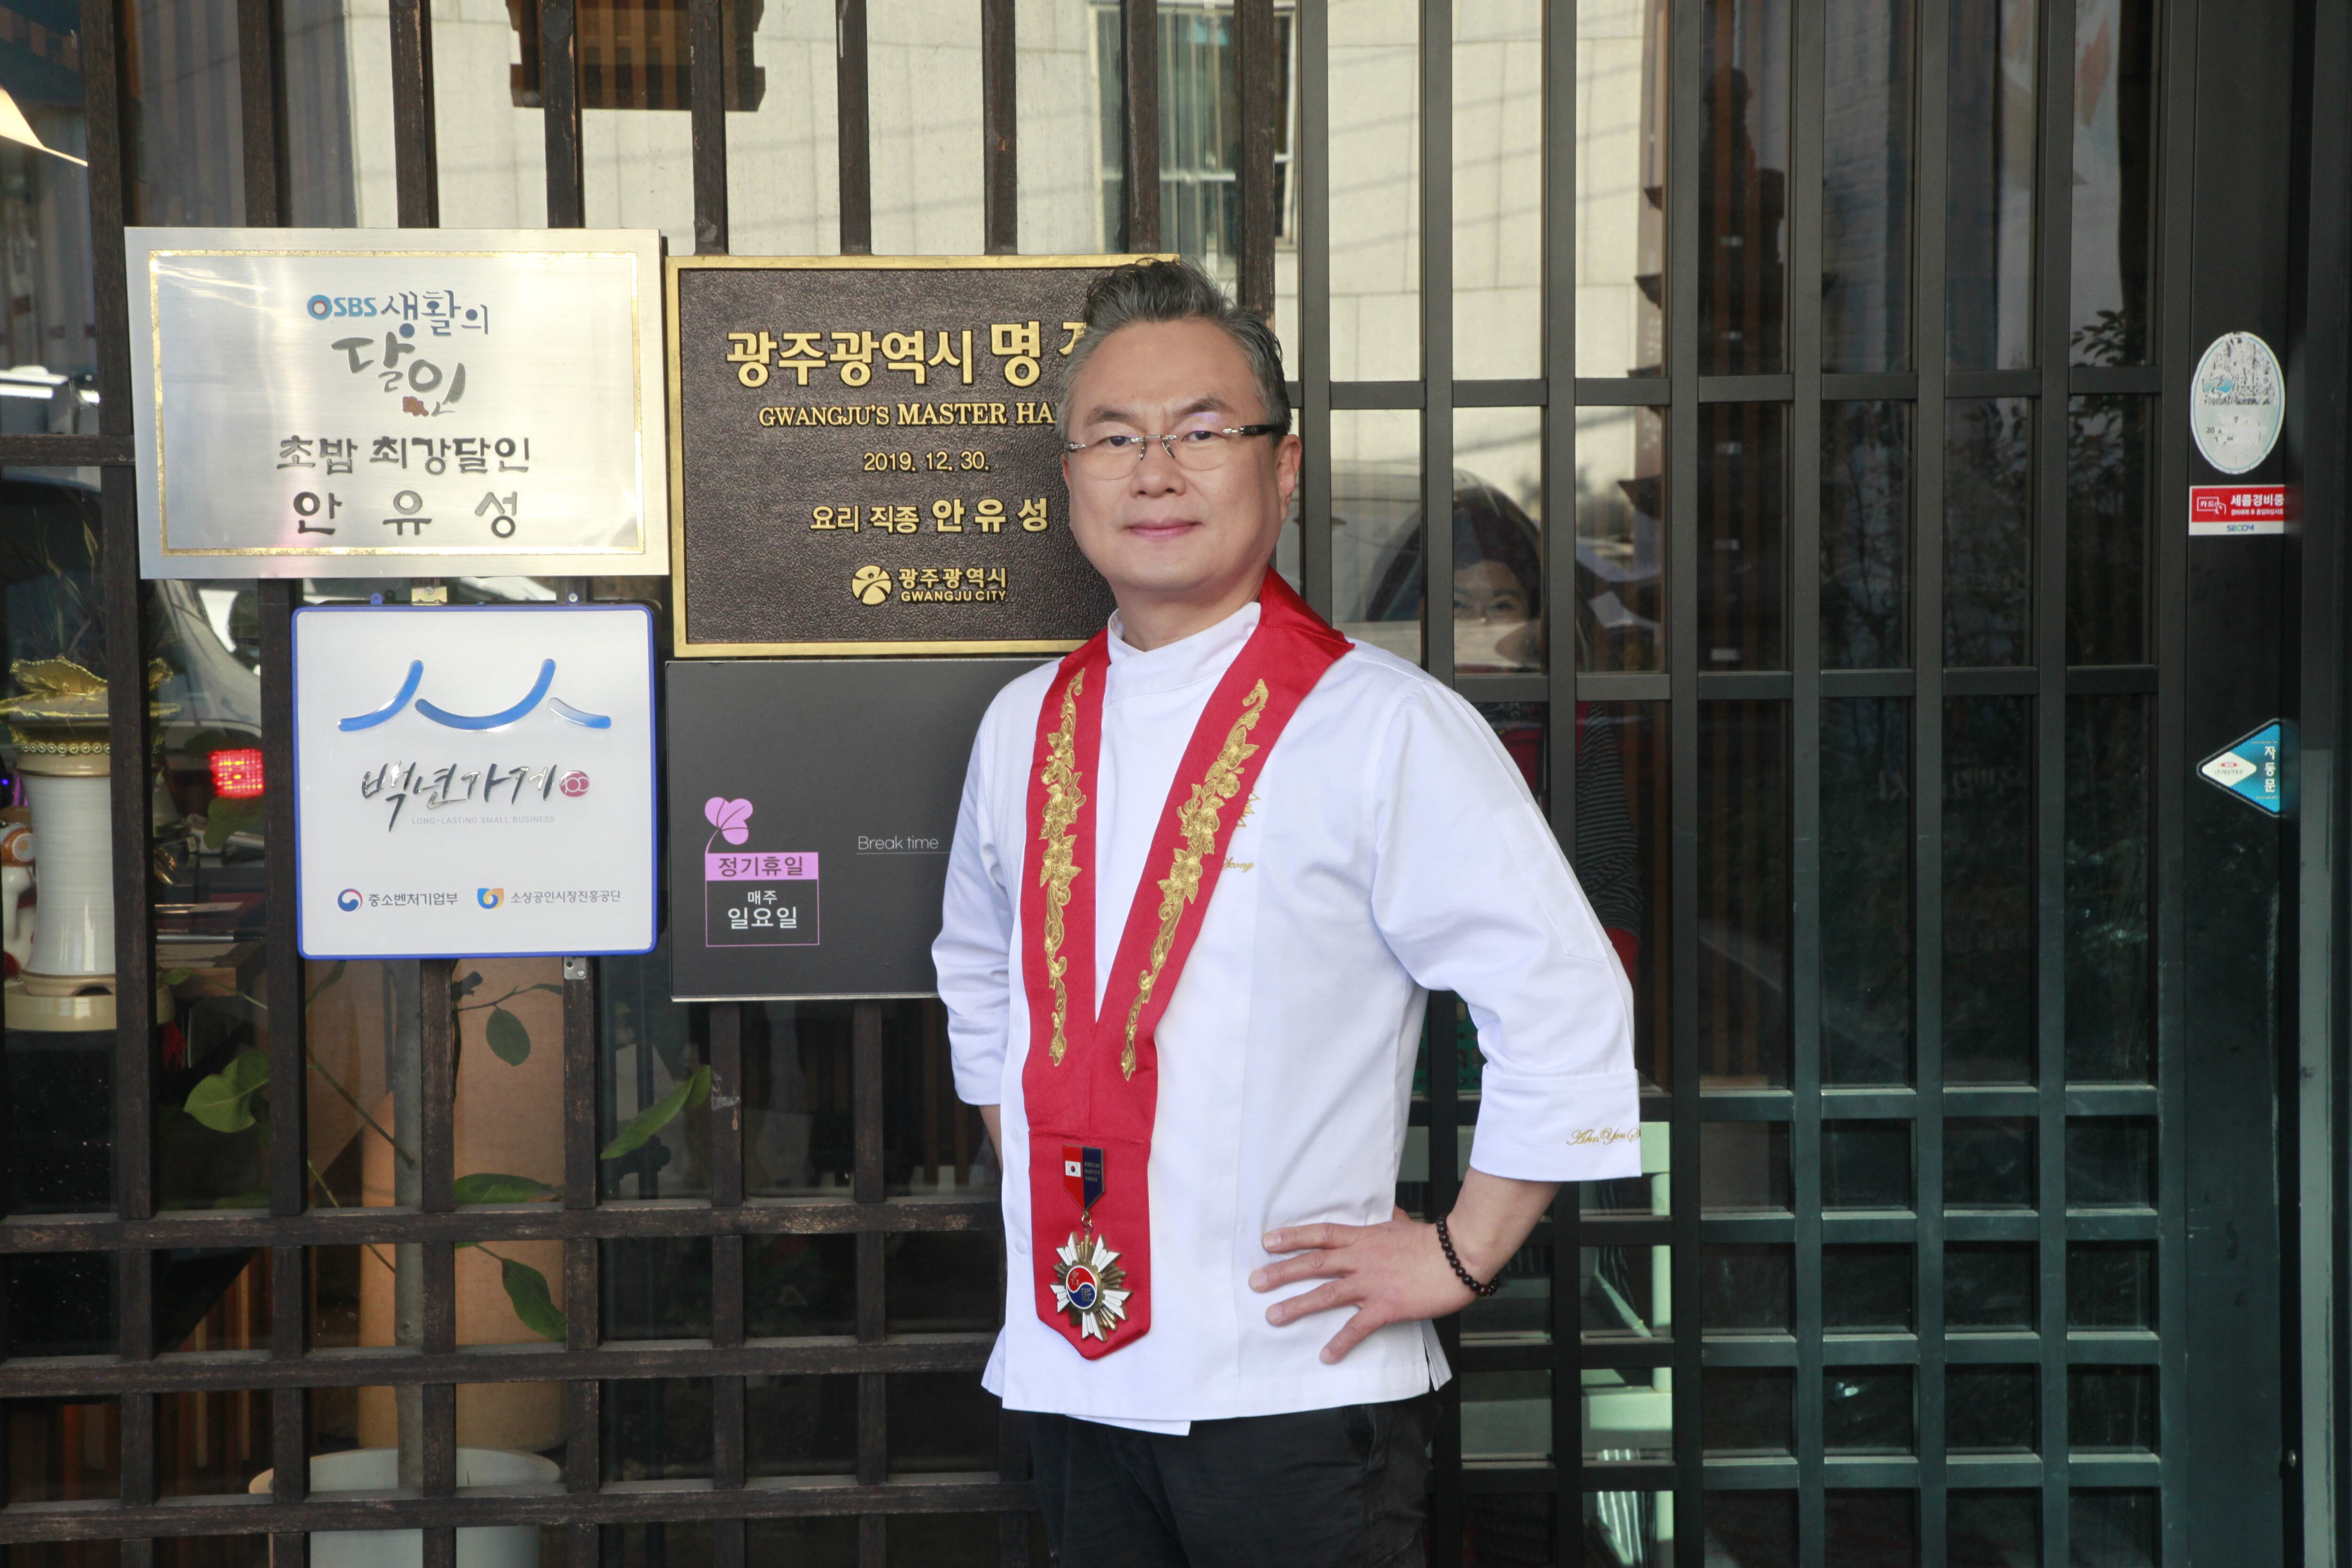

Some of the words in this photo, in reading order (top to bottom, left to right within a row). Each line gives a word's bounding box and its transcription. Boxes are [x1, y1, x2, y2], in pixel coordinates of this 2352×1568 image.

[334, 297, 377, 317] SBS
[380, 289, 489, 339] 생활의
[727, 330, 973, 387] 광주광역시
[331, 331, 466, 417] 달인
[759, 404, 890, 426] GWANGJU'S
[897, 403, 1007, 425] MASTER
[1016, 402, 1057, 424] HA
[276, 435, 358, 476] 초밥
[369, 436, 529, 476] 최강달인
[864, 452, 916, 471] 2019.
[926, 452, 953, 471] 12.
[961, 451, 989, 470] 30.
[2231, 493, 2284, 507] 세콤경비중
[810, 505, 859, 533] 요리
[869, 505, 920, 533] 직종
[898, 567, 1006, 589] 광주광역시
[900, 590, 972, 602] GWANGJU
[975, 590, 1006, 601] CITY
[2264, 746, 2277, 793] 자동문
[361, 760, 557, 833] 백년가게
[412, 817, 477, 825] LONG-LASTING
[858, 836, 903, 850] Break
[906, 836, 939, 849] time
[718, 856, 803, 877] 정기휴일
[368, 893, 459, 907] 중소벤처기업부
[510, 890, 621, 904] 소상공인시장진흥공단
[747, 890, 778, 905] 매주
[727, 906, 797, 930] 일요일
